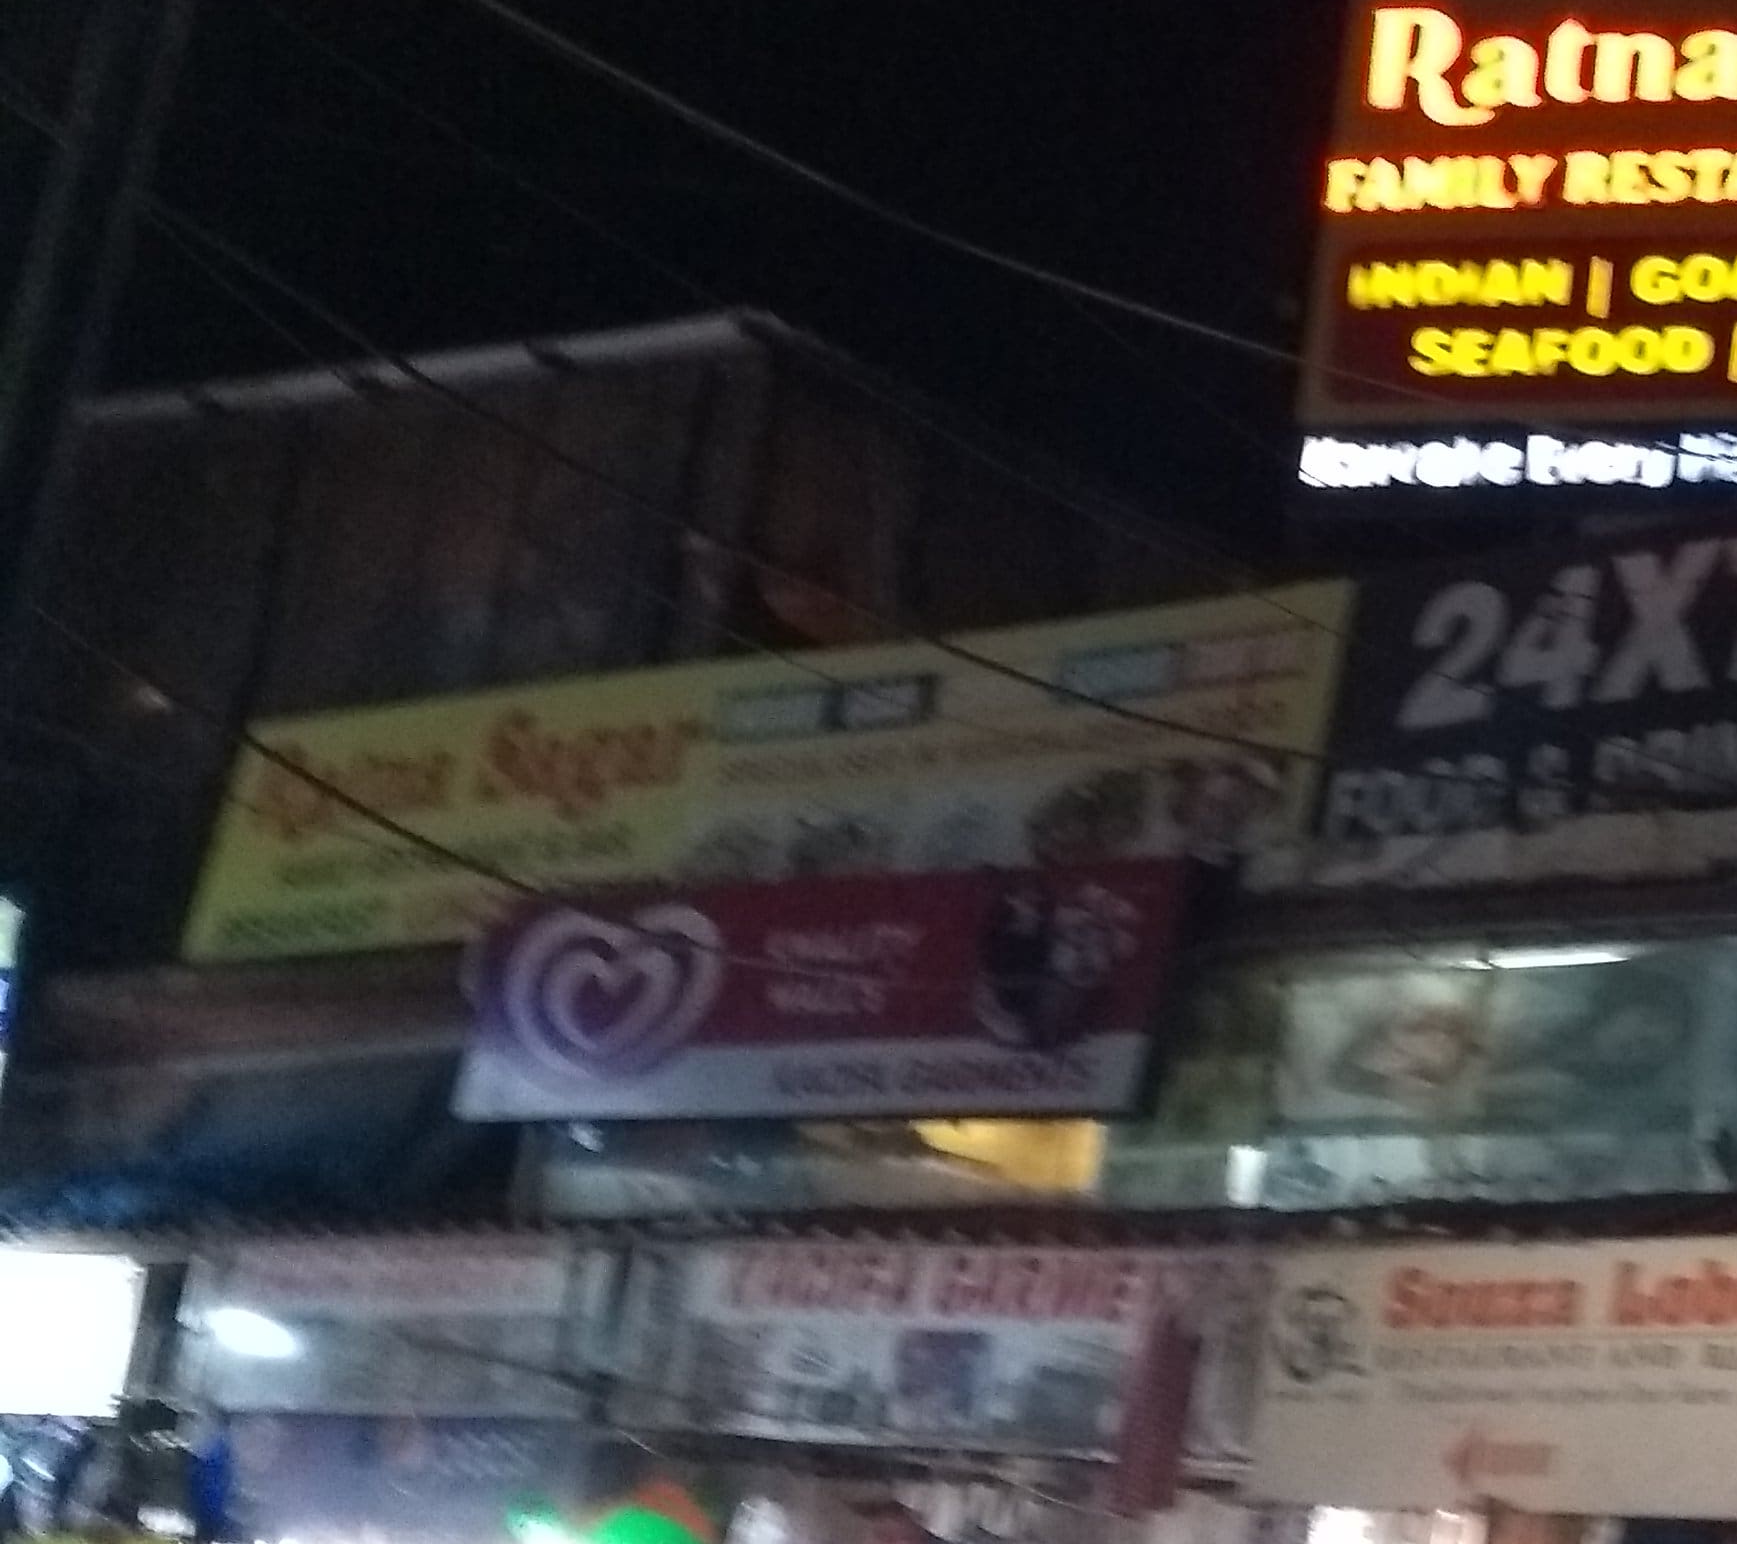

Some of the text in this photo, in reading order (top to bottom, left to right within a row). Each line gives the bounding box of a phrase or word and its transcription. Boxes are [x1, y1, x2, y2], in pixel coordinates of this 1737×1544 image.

[1324, 154, 1558, 213] FAMILY
[1348, 260, 1572, 310] INDIAN
[1408, 326, 1713, 378] SEAFOOD
